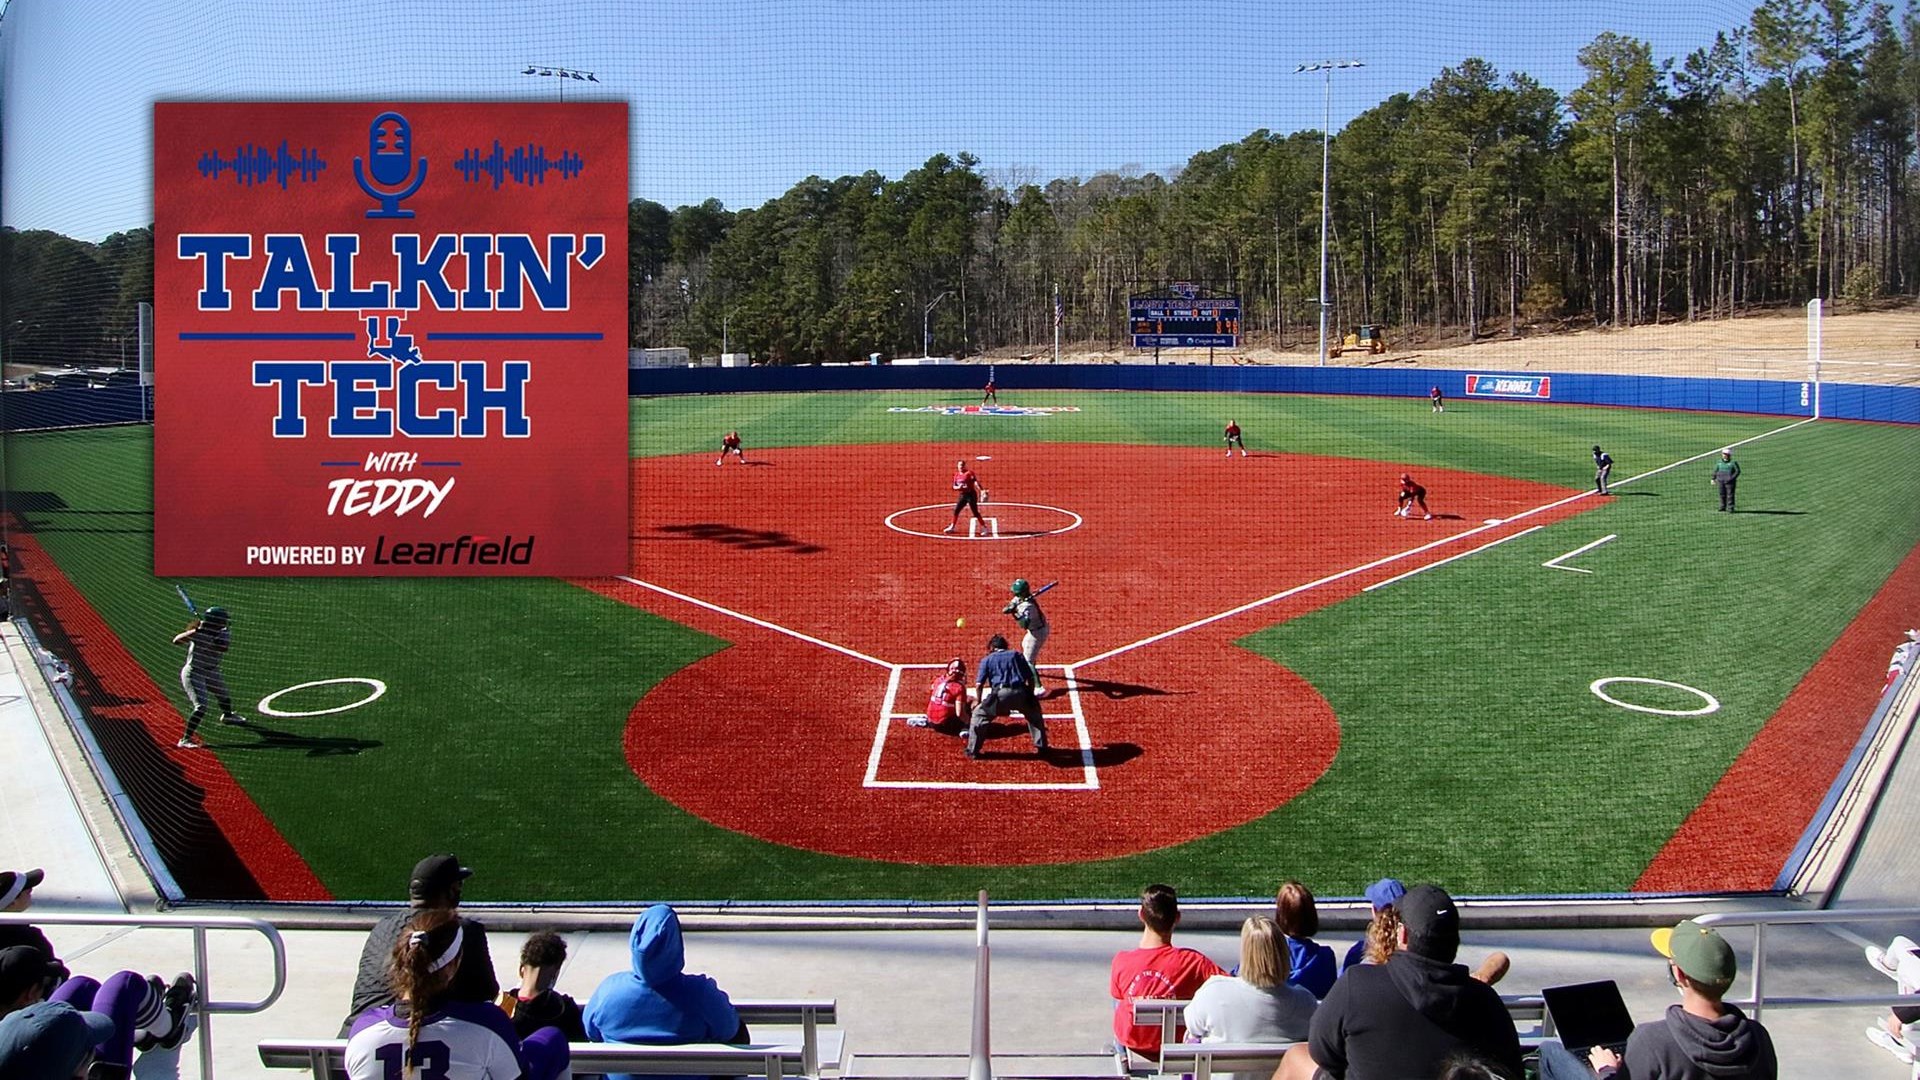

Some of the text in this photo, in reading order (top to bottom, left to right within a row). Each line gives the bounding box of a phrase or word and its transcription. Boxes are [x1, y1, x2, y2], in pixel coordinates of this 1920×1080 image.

[1495, 379, 1532, 393] KENNEL
[1800, 383, 1809, 406] 200
[375, 1040, 450, 1080] 13
